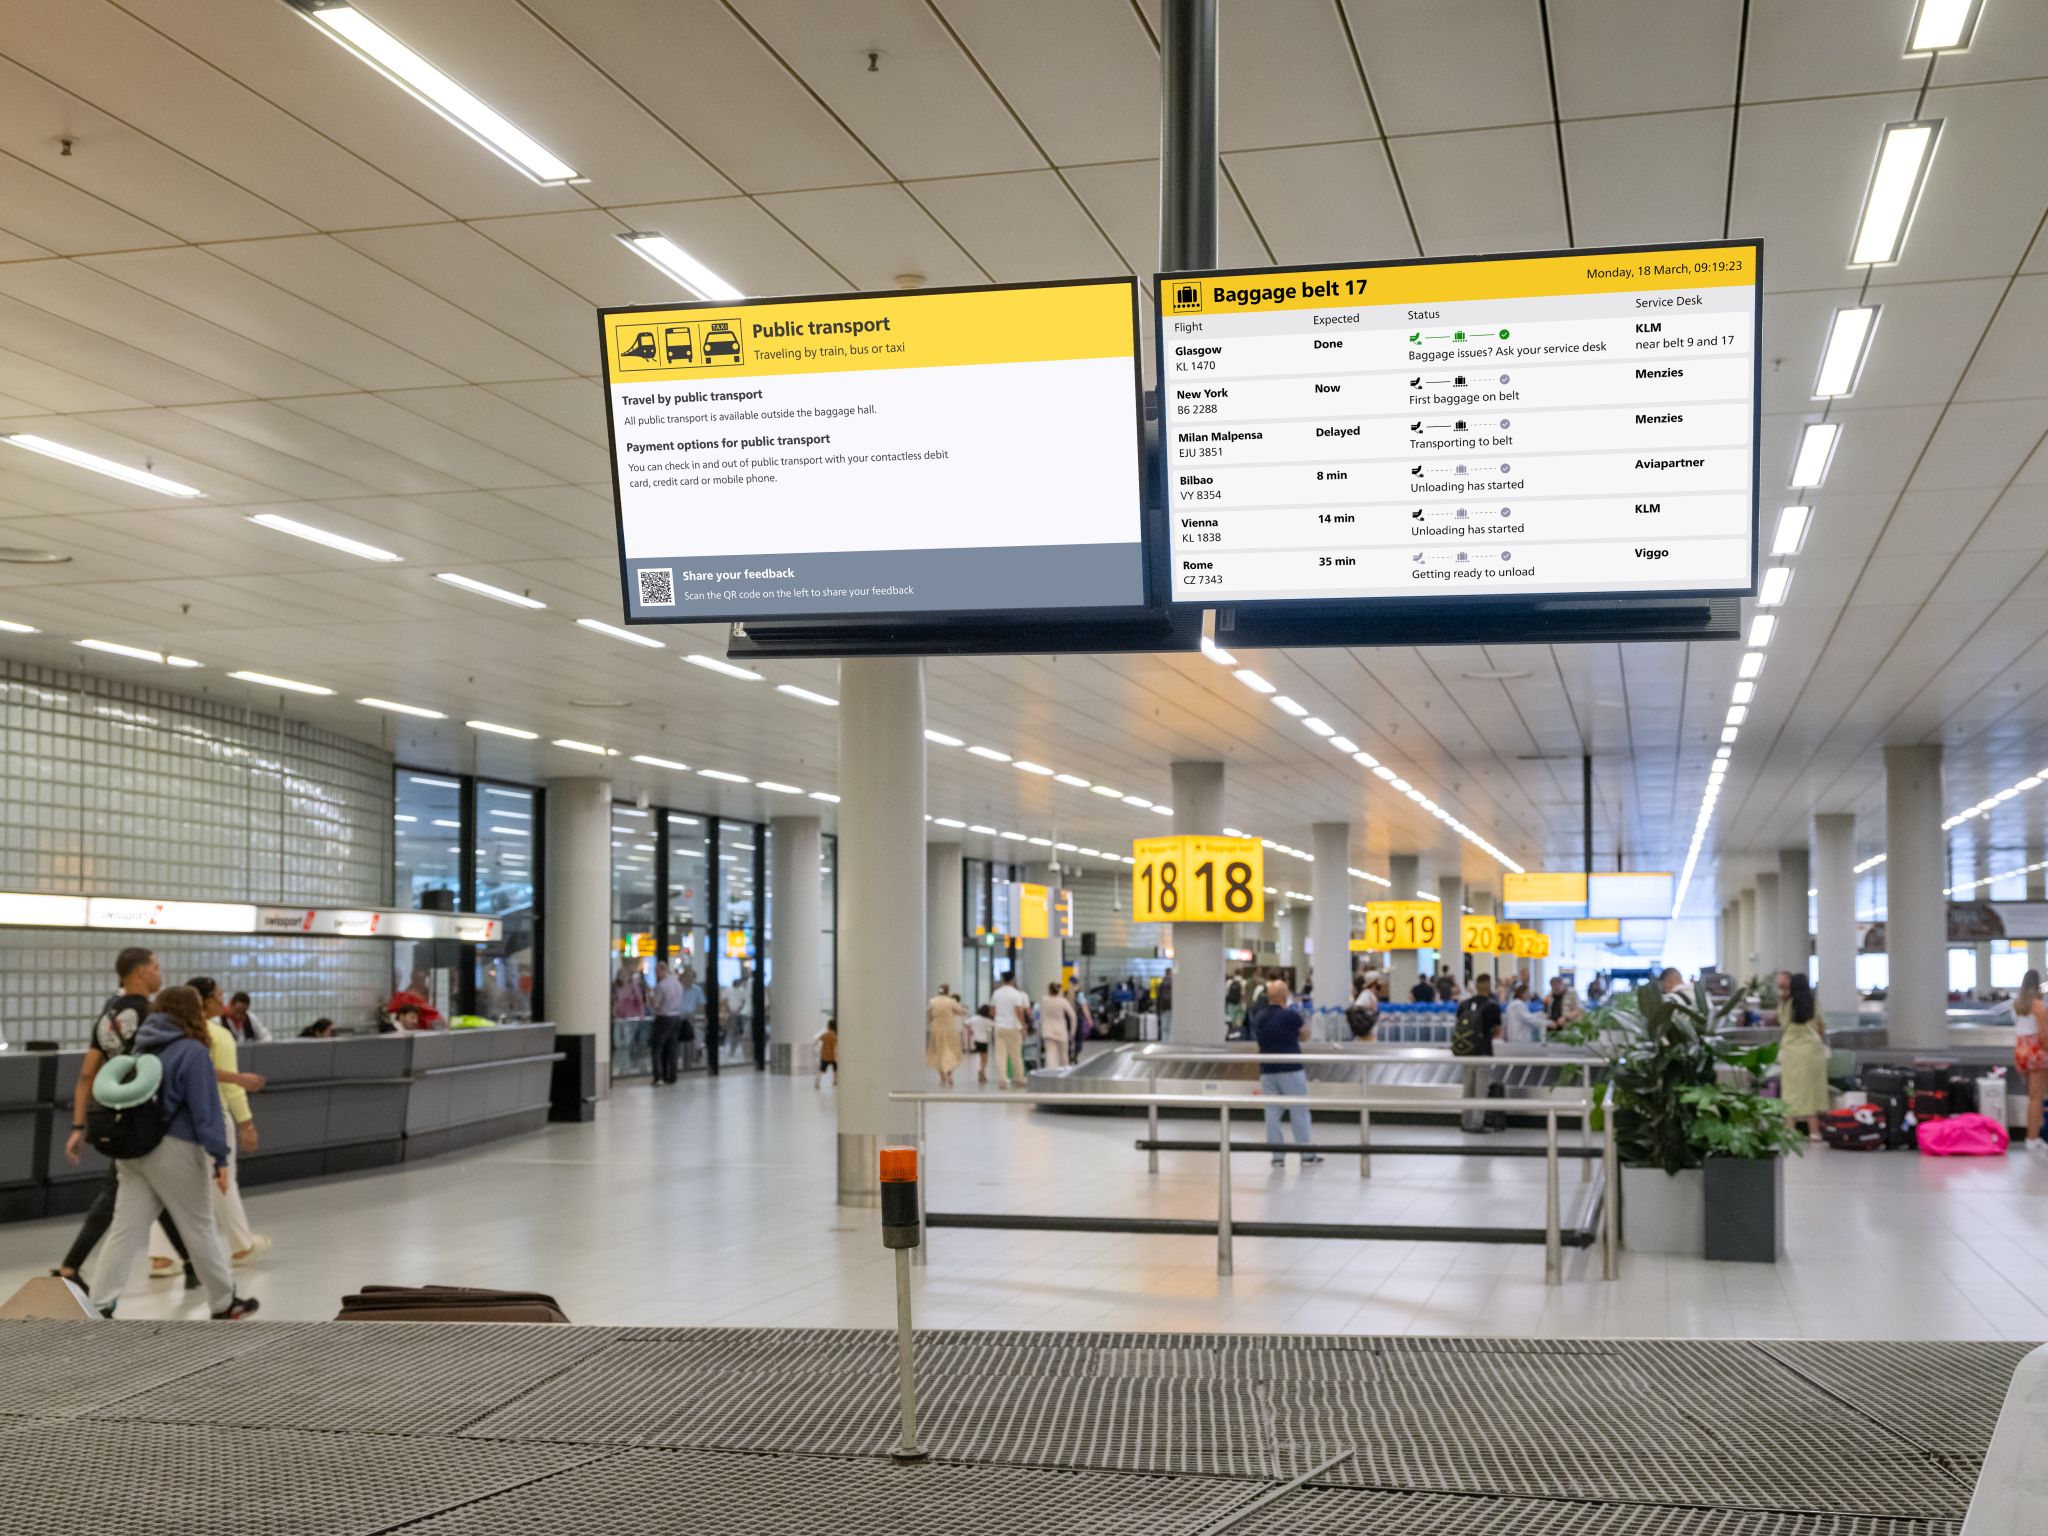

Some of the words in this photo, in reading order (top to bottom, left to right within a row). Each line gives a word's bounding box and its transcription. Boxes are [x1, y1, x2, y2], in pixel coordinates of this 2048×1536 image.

[1587, 266, 1635, 280] Monday,
[1638, 265, 1651, 276] 18
[1654, 263, 1691, 275] March,
[1694, 260, 1742, 273] 09:19:23
[1213, 286, 1297, 306] Baggage
[1302, 280, 1340, 298] belt
[1345, 279, 1368, 296] 17
[1635, 297, 1674, 309] Service
[1676, 294, 1703, 306] Desk
[1313, 312, 1360, 327] Expected
[1407, 310, 1440, 320] Status
[752, 320, 804, 339] Public
[807, 316, 891, 337] transport
[1174, 321, 1203, 334] Flight
[1635, 322, 1662, 333] KLM
[1314, 340, 1343, 349] Done
[1635, 341, 1661, 350] near
[1663, 337, 1684, 349] belt
[1687, 337, 1694, 348] 9
[1696, 335, 1718, 347] and
[1721, 335, 1735, 345] 17
[753, 348, 802, 361] Traveling
[804, 346, 817, 360] by
[819, 345, 847, 357] train,
[849, 344, 869, 355] bus
[871, 345, 884, 354] or
[885, 341, 905, 353] taxi
[1175, 346, 1222, 358] Glasgow
[1408, 350, 1455, 363] Baggage
[1457, 347, 1493, 358] issues?
[1495, 345, 1515, 356] Ask
[1516, 346, 1542, 358] your
[1543, 343, 1580, 354] service
[1582, 341, 1607, 353] desk
[1176, 362, 1188, 372] KL
[1191, 360, 1216, 371] 1470
[1635, 367, 1684, 379] Menzies
[1177, 390, 1202, 400] New
[1203, 387, 1228, 398] York
[1315, 384, 1341, 393] Now
[621, 393, 655, 406] Travel
[657, 393, 672, 407] by
[674, 391, 708, 406] public
[710, 389, 763, 403] transport
[1409, 395, 1431, 405] First
[1433, 393, 1480, 406] baggage
[1482, 393, 1496, 402] on
[1499, 390, 1520, 401] belt
[624, 416, 636, 426] All
[638, 415, 666, 427] public
[666, 413, 709, 425] transport
[710, 412, 718, 422] is
[718, 410, 759, 422] available
[760, 408, 795, 420] outside
[796, 408, 813, 418] the
[814, 407, 856, 419] baggage
[857, 404, 877, 415] hall.
[1177, 405, 1191, 415] B6
[1192, 404, 1218, 415] 2288
[1635, 413, 1684, 424] Menzies
[1178, 432, 1209, 443] Milan
[1211, 431, 1263, 443] Malpensa
[1316, 425, 1361, 439] Delayed
[626, 441, 675, 455] Payment
[677, 439, 719, 452] options
[721, 437, 739, 448] for
[740, 436, 775, 450] public
[777, 434, 831, 447] transport
[1409, 437, 1476, 450] Transporting
[1478, 437, 1490, 446] to
[1492, 435, 1513, 446] belt
[1179, 448, 1196, 458] EJU
[1199, 447, 1222, 457] 3851
[627, 463, 645, 472] You
[647, 464, 663, 472] can
[664, 460, 690, 471] check
[691, 460, 701, 470] in
[702, 459, 720, 469] and
[721, 460, 738, 469] out
[739, 457, 749, 468] of
[751, 457, 779, 469] public
[780, 456, 823, 467] transport
[824, 453, 846, 464] with
[847, 455, 869, 466] your
[870, 451, 922, 462] contactless
[923, 449, 949, 460] debit
[1635, 458, 1705, 471] Aviapartner
[629, 478, 651, 489] card,
[652, 477, 679, 487] credit
[679, 476, 699, 486] card
[701, 477, 711, 485] or
[712, 474, 744, 485] mobile
[745, 473, 778, 486] phone.
[1180, 475, 1214, 486] Bilbao
[1316, 471, 1324, 481] 8
[1326, 470, 1348, 480] min
[1410, 481, 1465, 494] Unloading
[1467, 480, 1485, 491] has
[1487, 479, 1524, 490] started
[1180, 491, 1195, 501] VY
[1196, 490, 1222, 500] 8354
[1635, 503, 1661, 514] KLM
[1181, 518, 1219, 528] Vienna
[1318, 514, 1332, 524] 14
[1334, 513, 1355, 523] min
[1411, 525, 1465, 537] Unloading
[1467, 524, 1486, 534] has
[1487, 523, 1525, 534] started
[1182, 533, 1195, 543] KL
[1197, 532, 1222, 543] 1838
[1634, 548, 1669, 560] Viggo
[1183, 561, 1214, 570] Rome
[1319, 557, 1332, 567] 35
[1335, 556, 1356, 566] min
[682, 570, 714, 581] Share
[715, 571, 742, 583] your
[743, 567, 795, 579] feedback
[1183, 575, 1196, 585] CZ
[1198, 574, 1223, 585] 7343
[1411, 569, 1451, 581] Getting
[1453, 568, 1483, 580] ready
[1484, 569, 1496, 578] to
[1498, 566, 1535, 577] unload
[684, 591, 705, 601] Scan
[706, 590, 722, 600] the
[723, 590, 738, 601] QR
[738, 589, 761, 599] code
[762, 591, 775, 599] on
[776, 588, 792, 598] the
[793, 587, 810, 598] left
[810, 589, 821, 597] to
[822, 587, 848, 597] share
[848, 588, 870, 598] your
[871, 584, 914, 596] feedback
[1141, 861, 1178, 914] 18
[1194, 861, 1254, 914] 18
[1372, 915, 1397, 944] 19
[1406, 915, 1436, 944] 19
[1468, 926, 1493, 949] 20
[1497, 932, 1516, 951] 20
